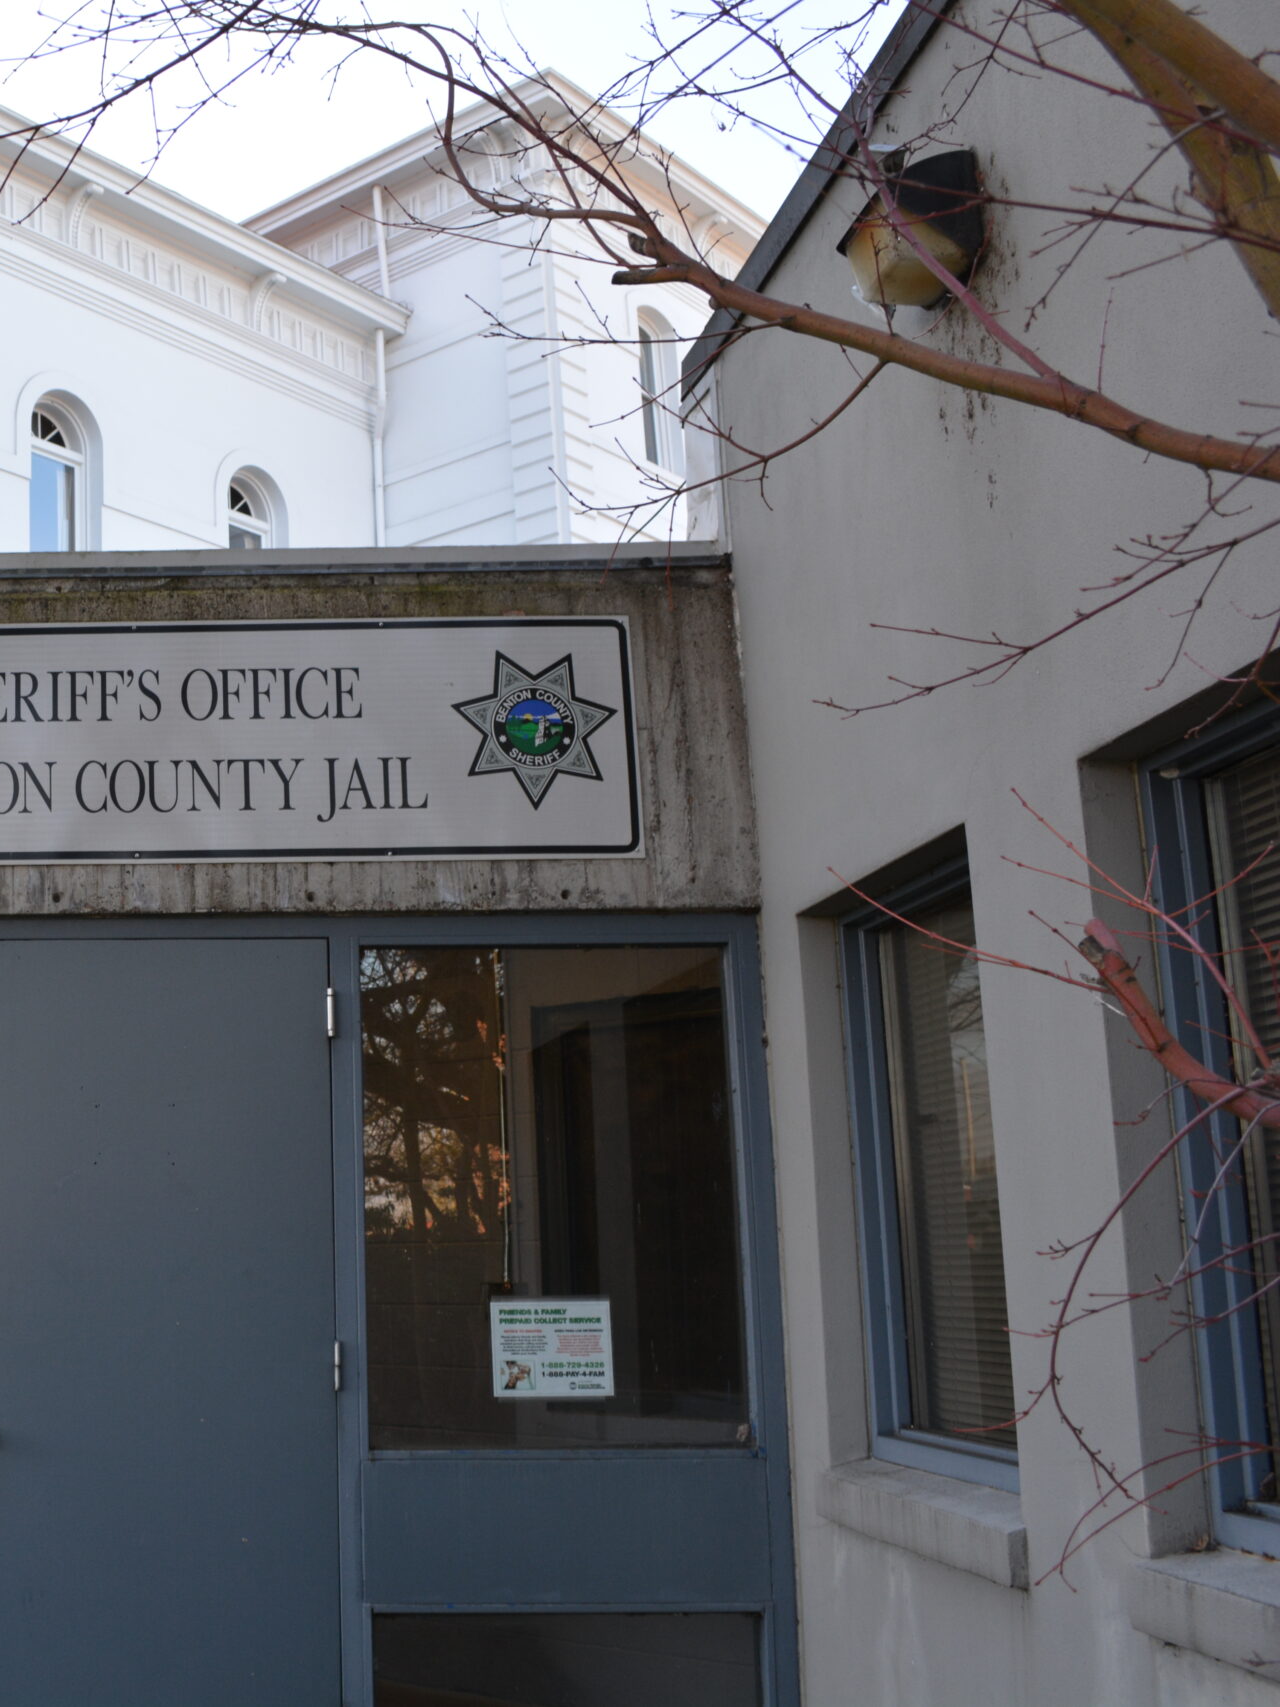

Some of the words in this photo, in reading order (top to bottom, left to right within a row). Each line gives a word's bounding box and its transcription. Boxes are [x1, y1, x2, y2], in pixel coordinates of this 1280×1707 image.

[181, 667, 362, 722] OFFICE
[496, 690, 531, 723] BENTON
[536, 690, 573, 724] COUNTY
[510, 748, 561, 765] SHERIFF
[75, 759, 306, 814] COUNTY
[317, 757, 428, 822] JAIL
